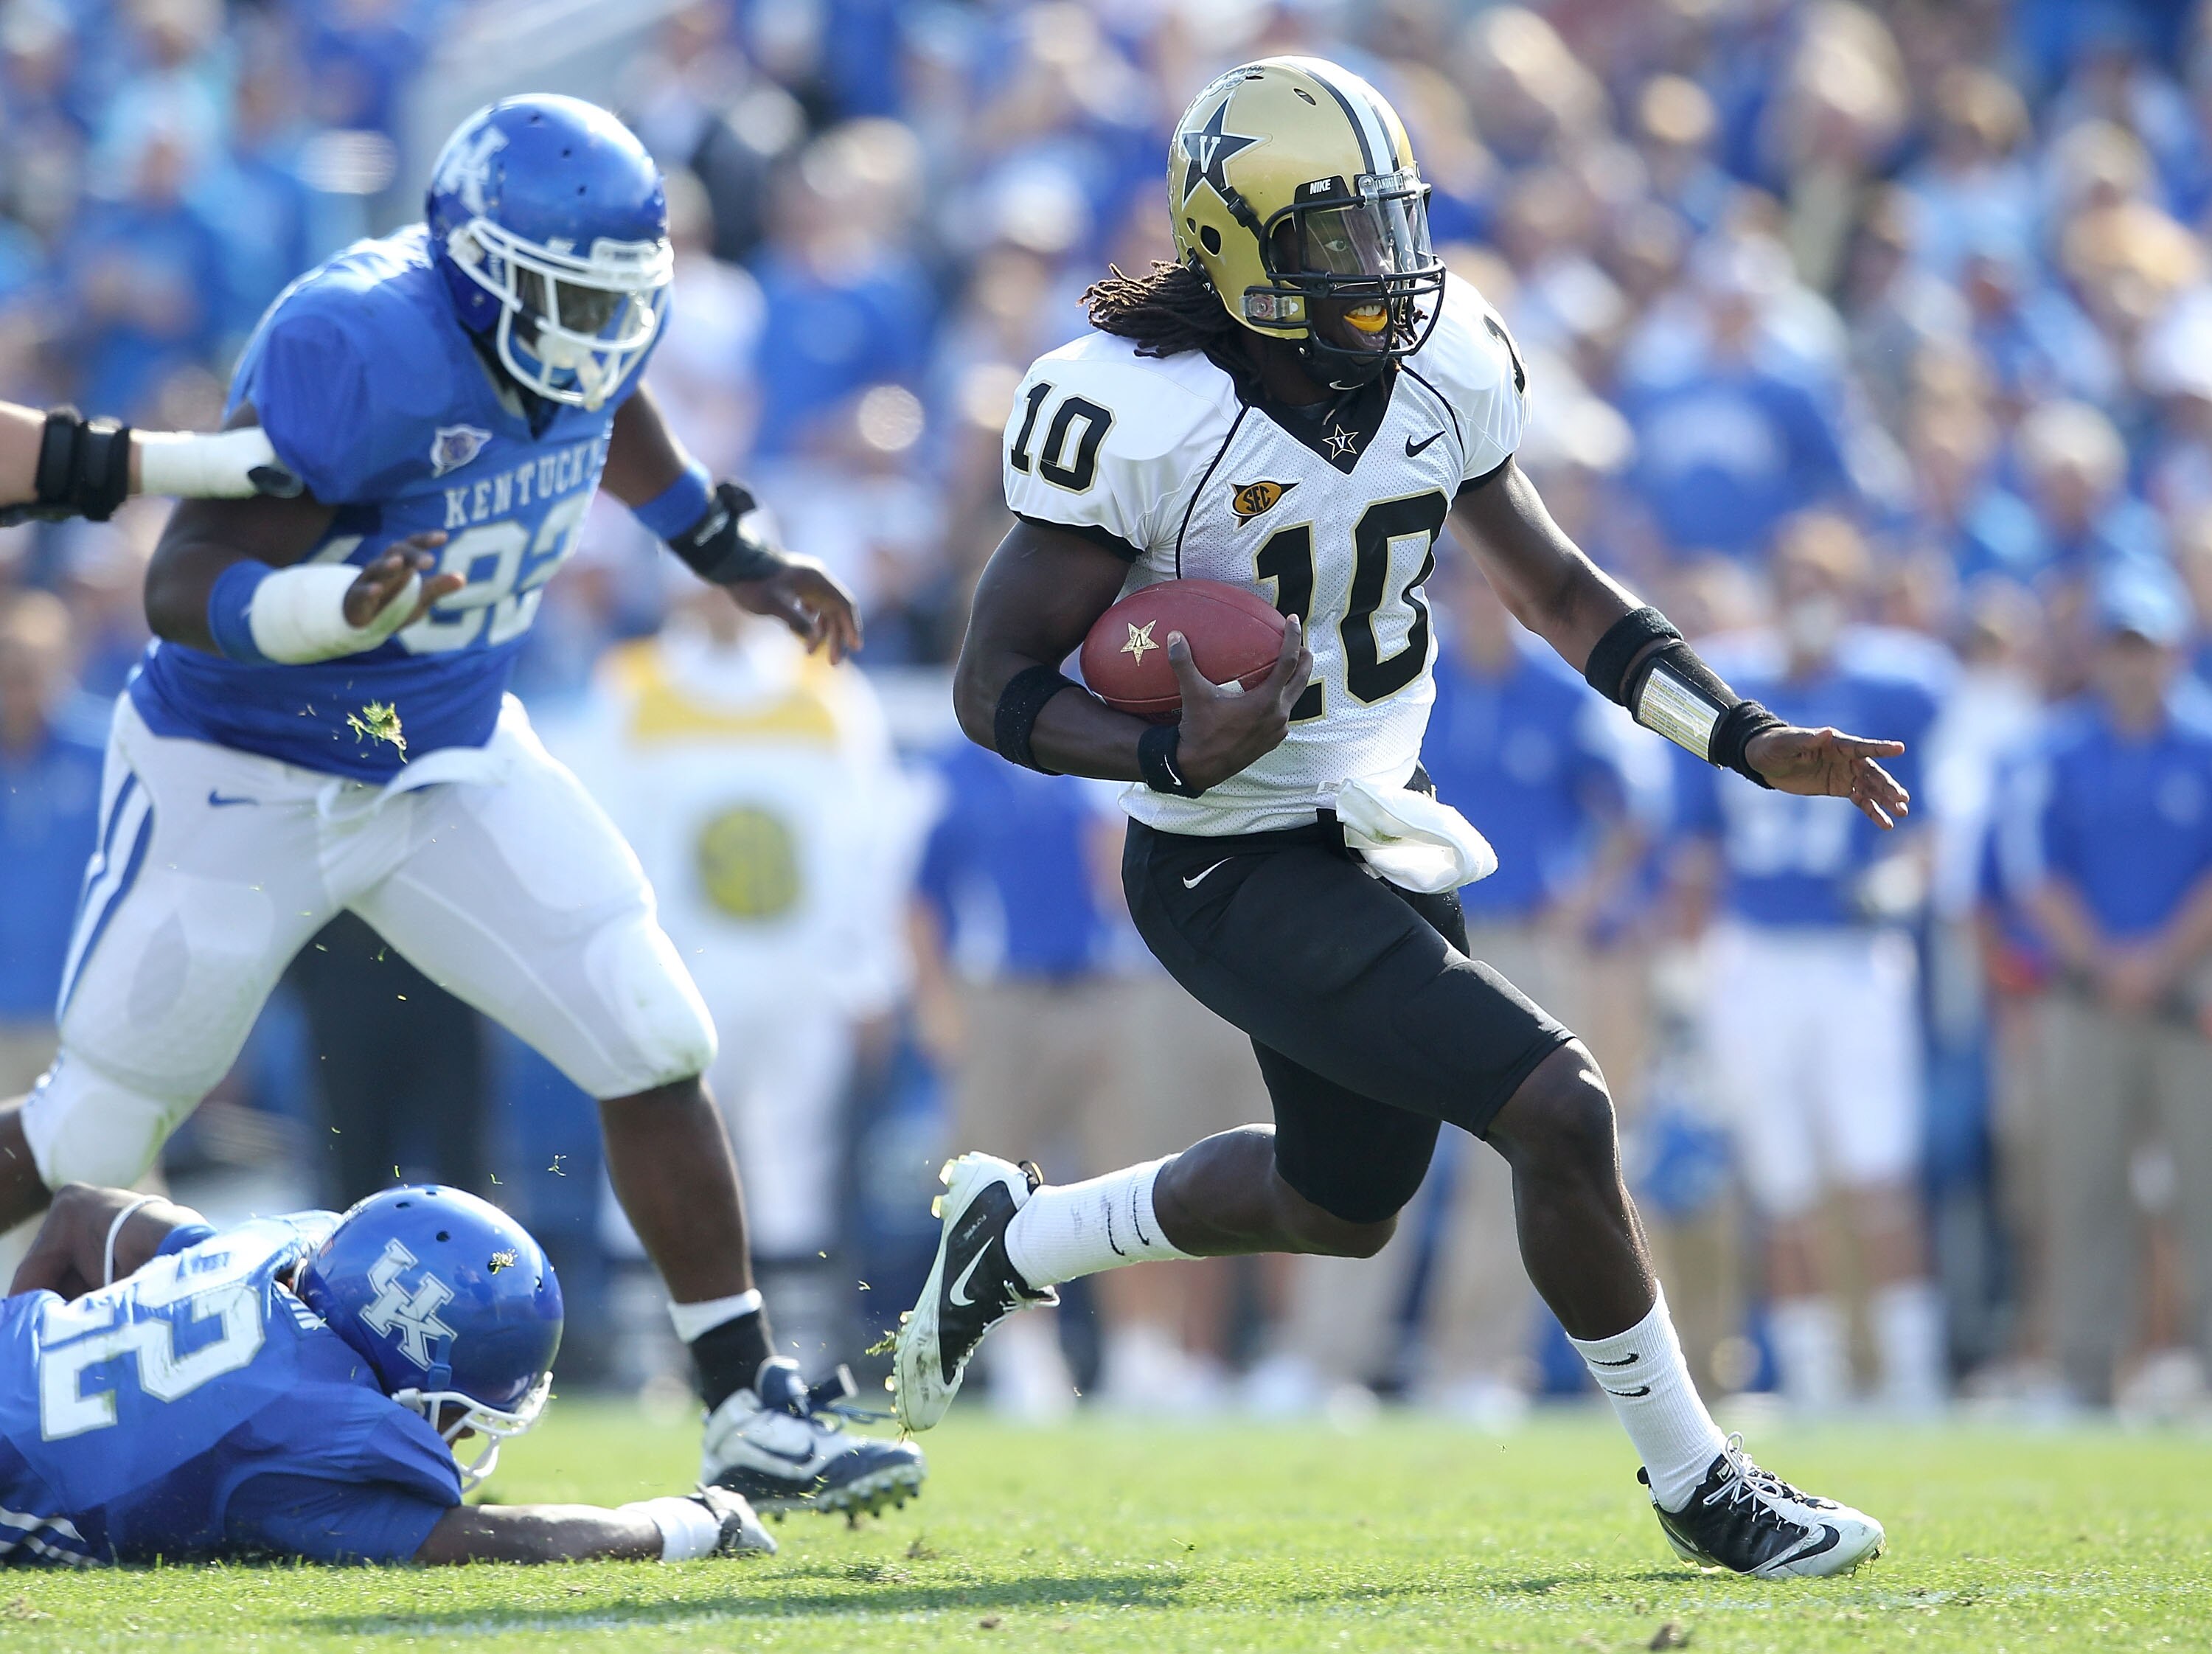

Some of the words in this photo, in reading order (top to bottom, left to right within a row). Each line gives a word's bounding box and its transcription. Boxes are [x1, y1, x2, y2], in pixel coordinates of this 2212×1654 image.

[1199, 135, 1222, 174] V
[1310, 178, 1332, 195] NIKE
[1010, 379, 1118, 496] 10
[1334, 435, 1346, 449] V
[1242, 485, 1271, 513] SEC
[1253, 487, 1450, 726] 10
